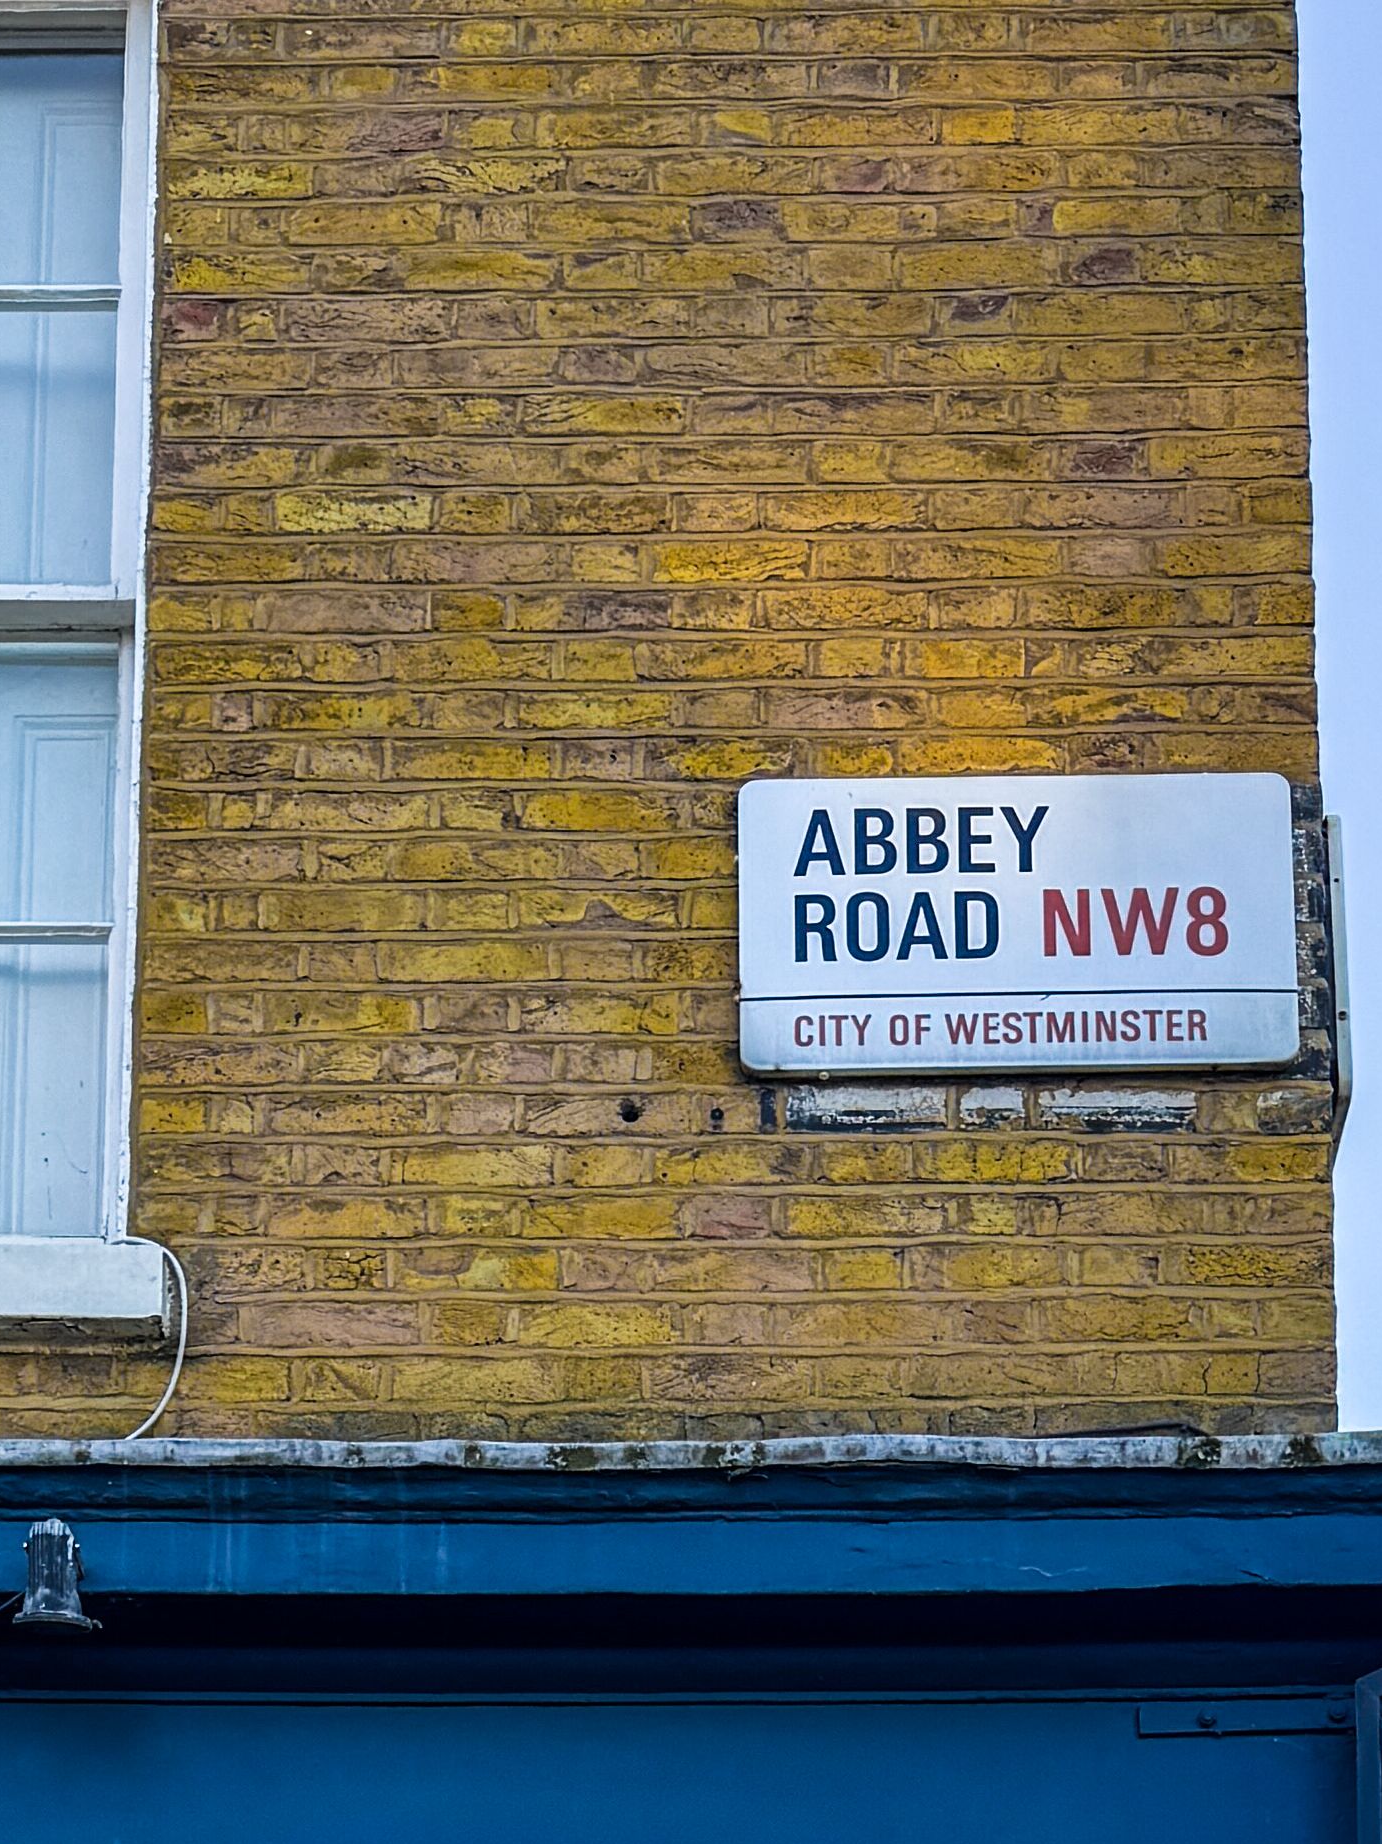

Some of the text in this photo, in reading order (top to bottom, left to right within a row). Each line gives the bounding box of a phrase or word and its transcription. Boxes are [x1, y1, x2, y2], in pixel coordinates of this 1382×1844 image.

[794, 806, 1050, 877] ABBEY
[794, 886, 1230, 963] ROAD NW8
[794, 1009, 1209, 1048] CITY OF WESTMINSTER
